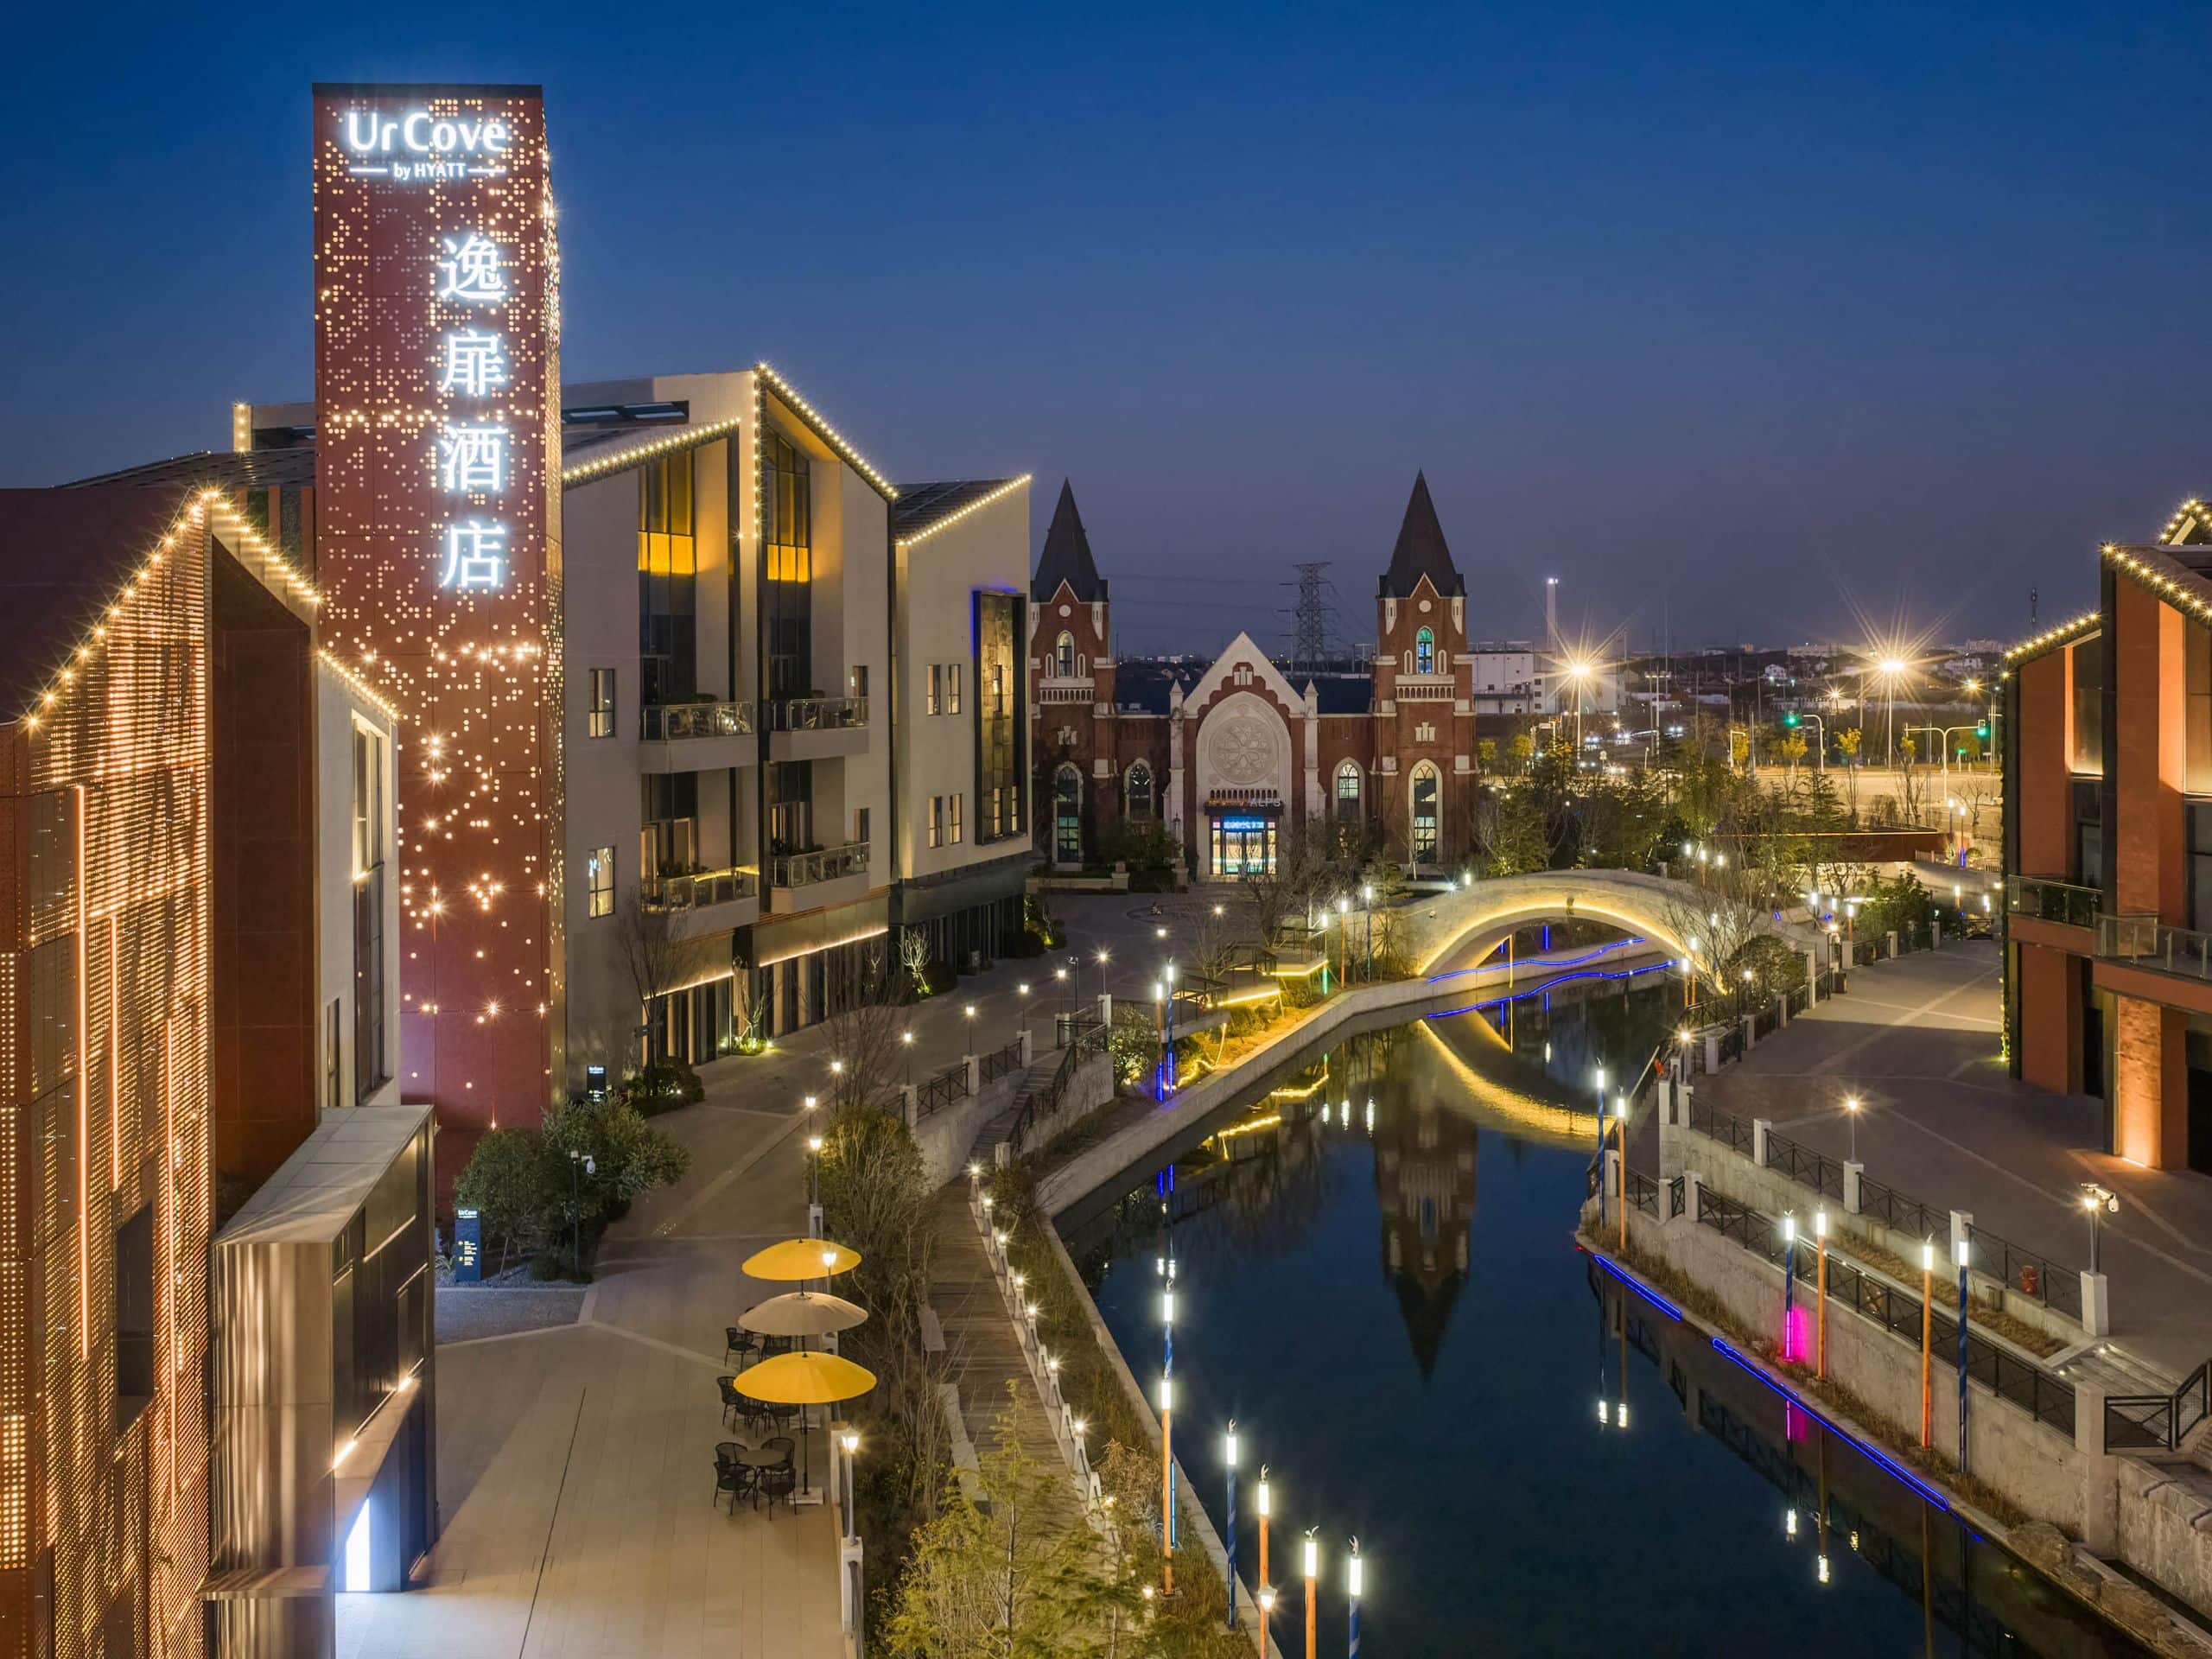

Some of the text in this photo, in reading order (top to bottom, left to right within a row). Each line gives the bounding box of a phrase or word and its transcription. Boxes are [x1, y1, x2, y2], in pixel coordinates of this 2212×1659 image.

[394, 162, 467, 180] by HYATT
[440, 235, 508, 588] 逸扉酒店
